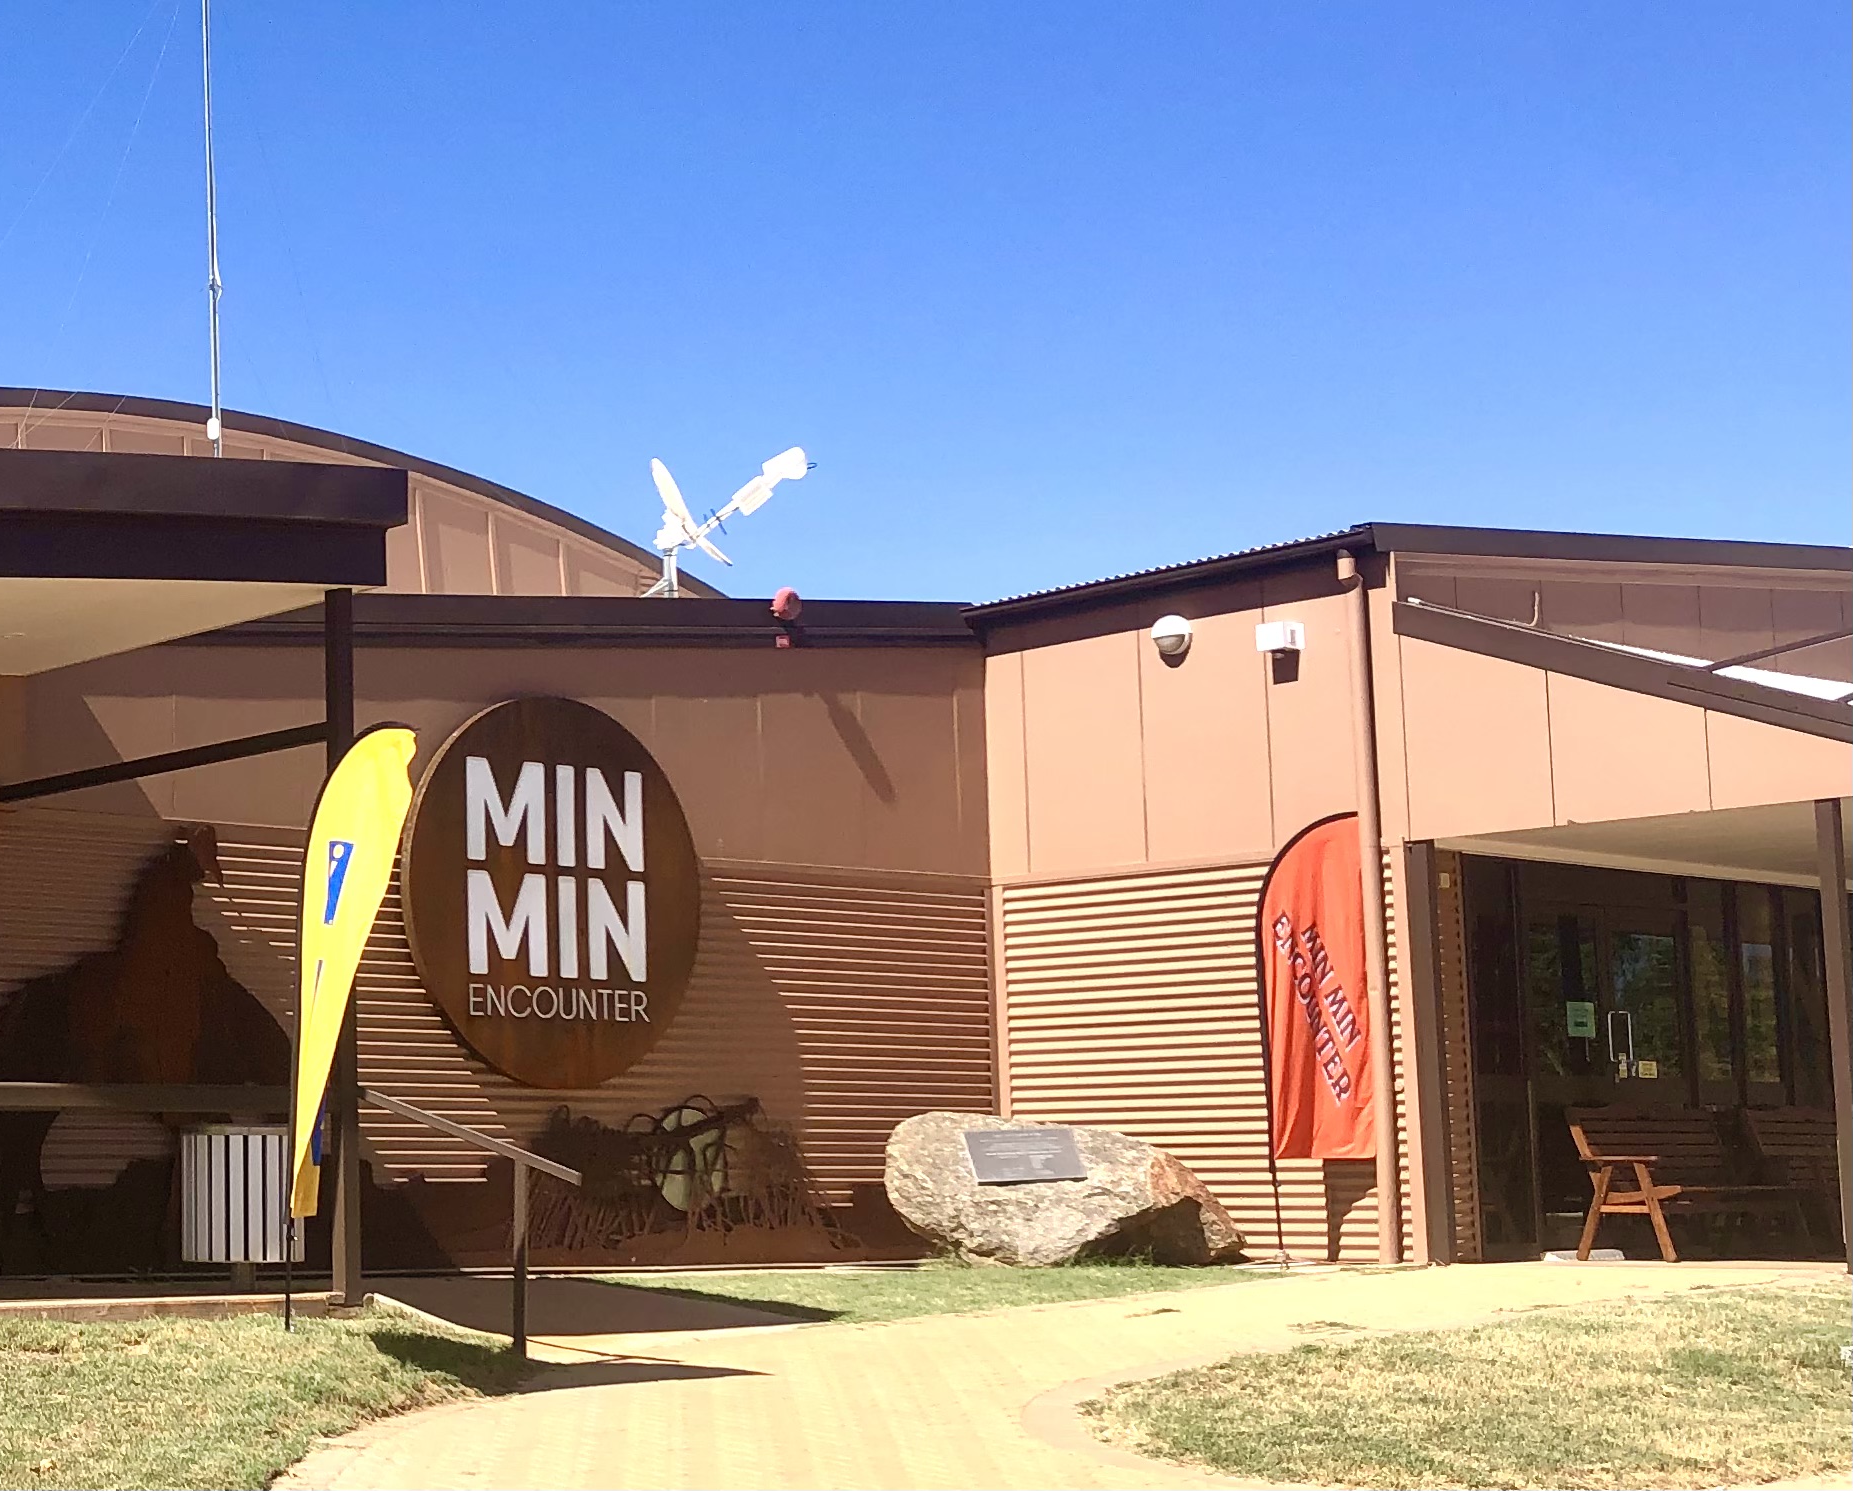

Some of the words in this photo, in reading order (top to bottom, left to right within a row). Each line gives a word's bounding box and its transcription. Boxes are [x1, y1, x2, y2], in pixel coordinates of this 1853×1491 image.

[465, 755, 645, 873] MIN
[466, 868, 647, 983] MIN
[468, 982, 651, 1023] ENCOUNTER
[1300, 920, 1336, 990] MIN
[1323, 983, 1362, 1053] MIN
